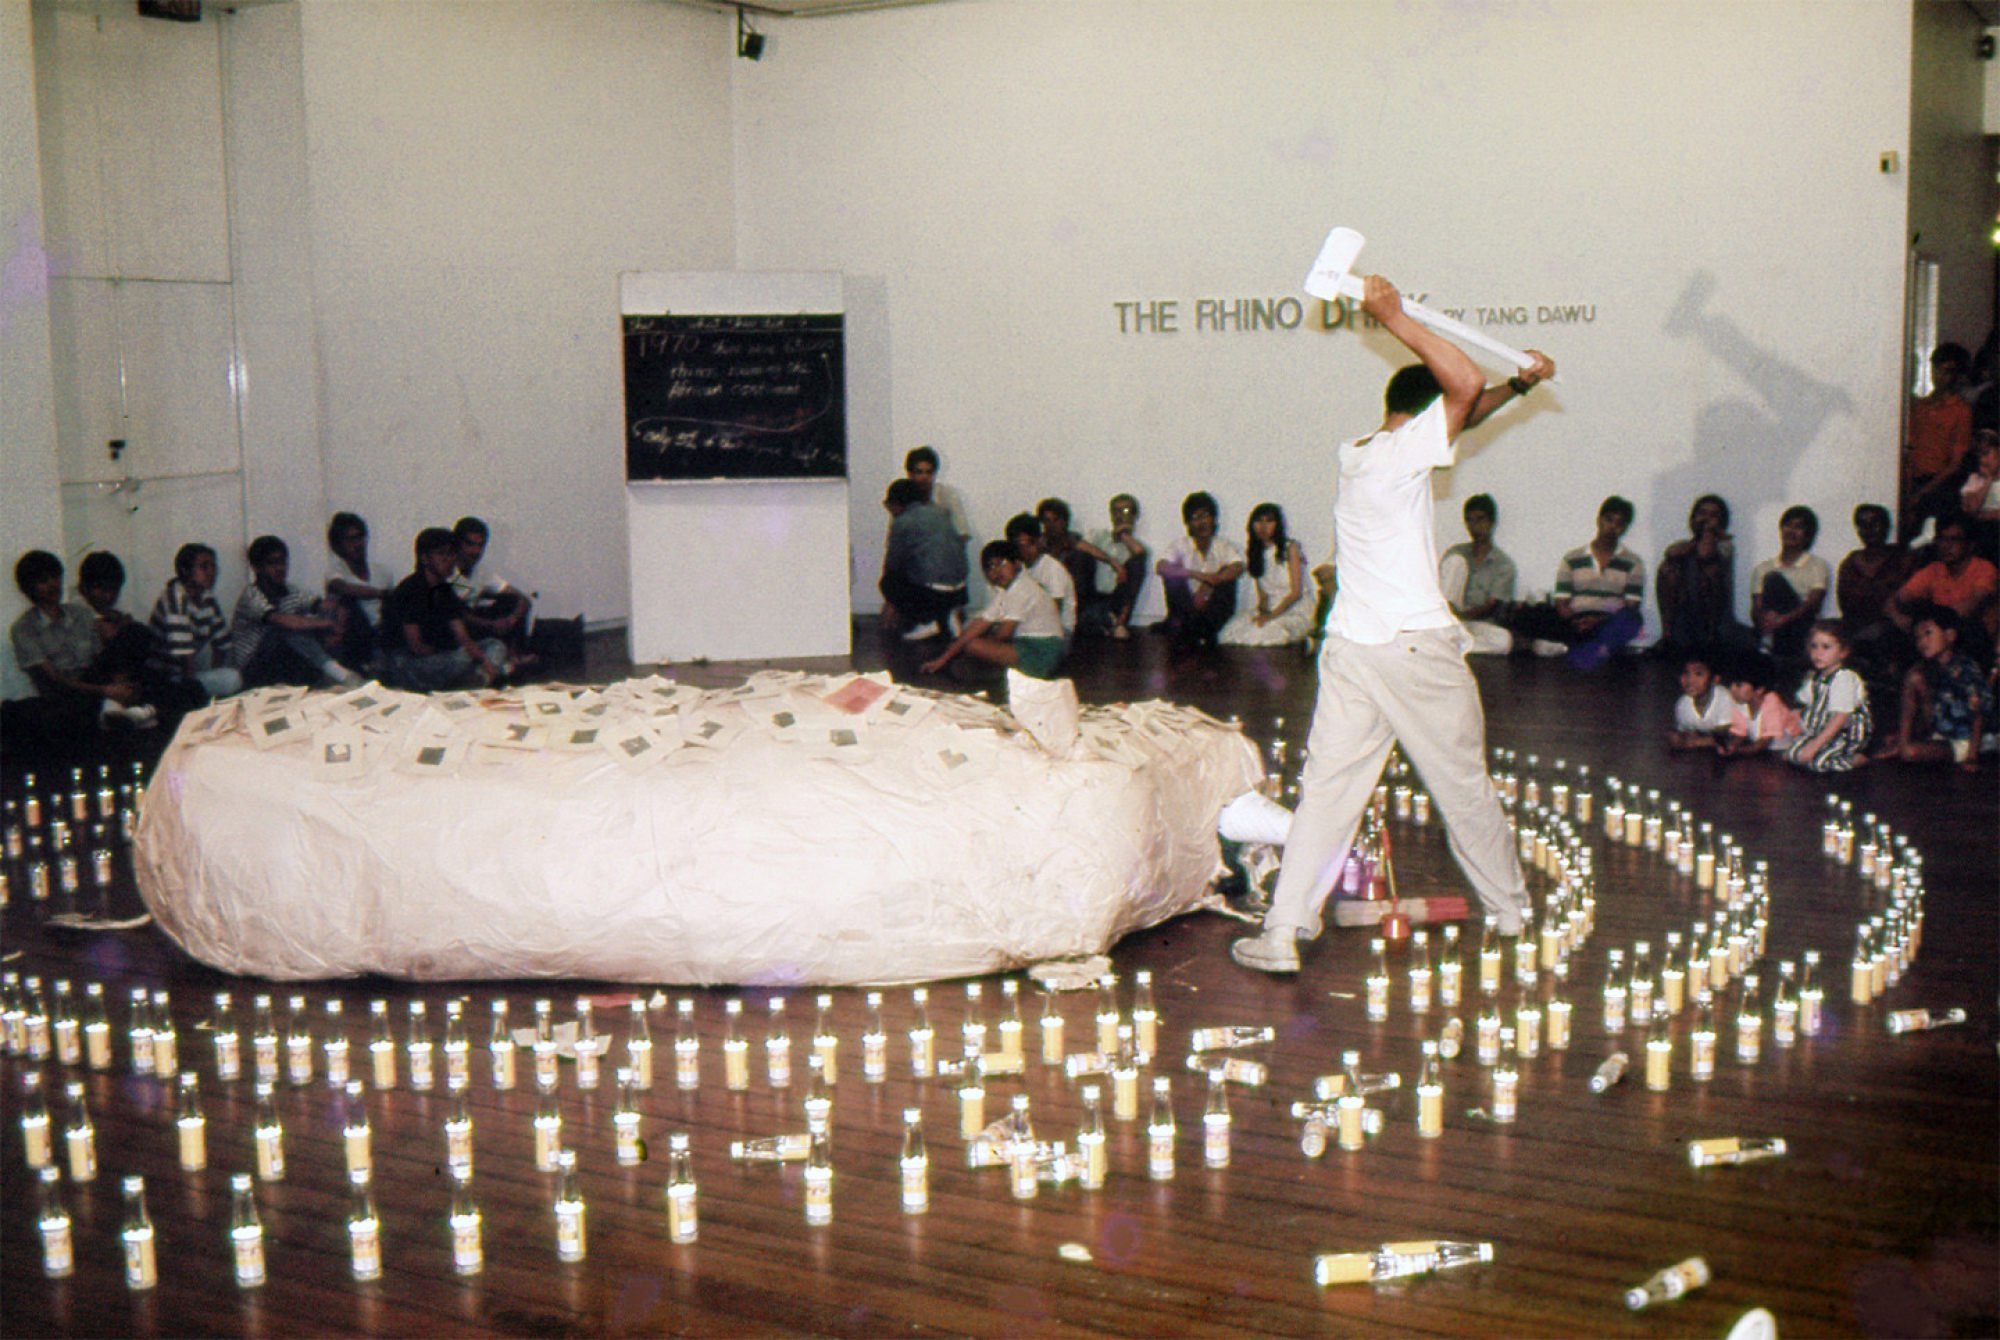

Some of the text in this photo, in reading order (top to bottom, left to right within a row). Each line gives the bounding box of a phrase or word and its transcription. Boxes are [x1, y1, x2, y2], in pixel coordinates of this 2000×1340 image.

[1114, 301, 1178, 333] THE
[1195, 297, 1303, 331] RHINO
[1476, 307, 1528, 325] TANG
[1537, 304, 1596, 323] DAWU
